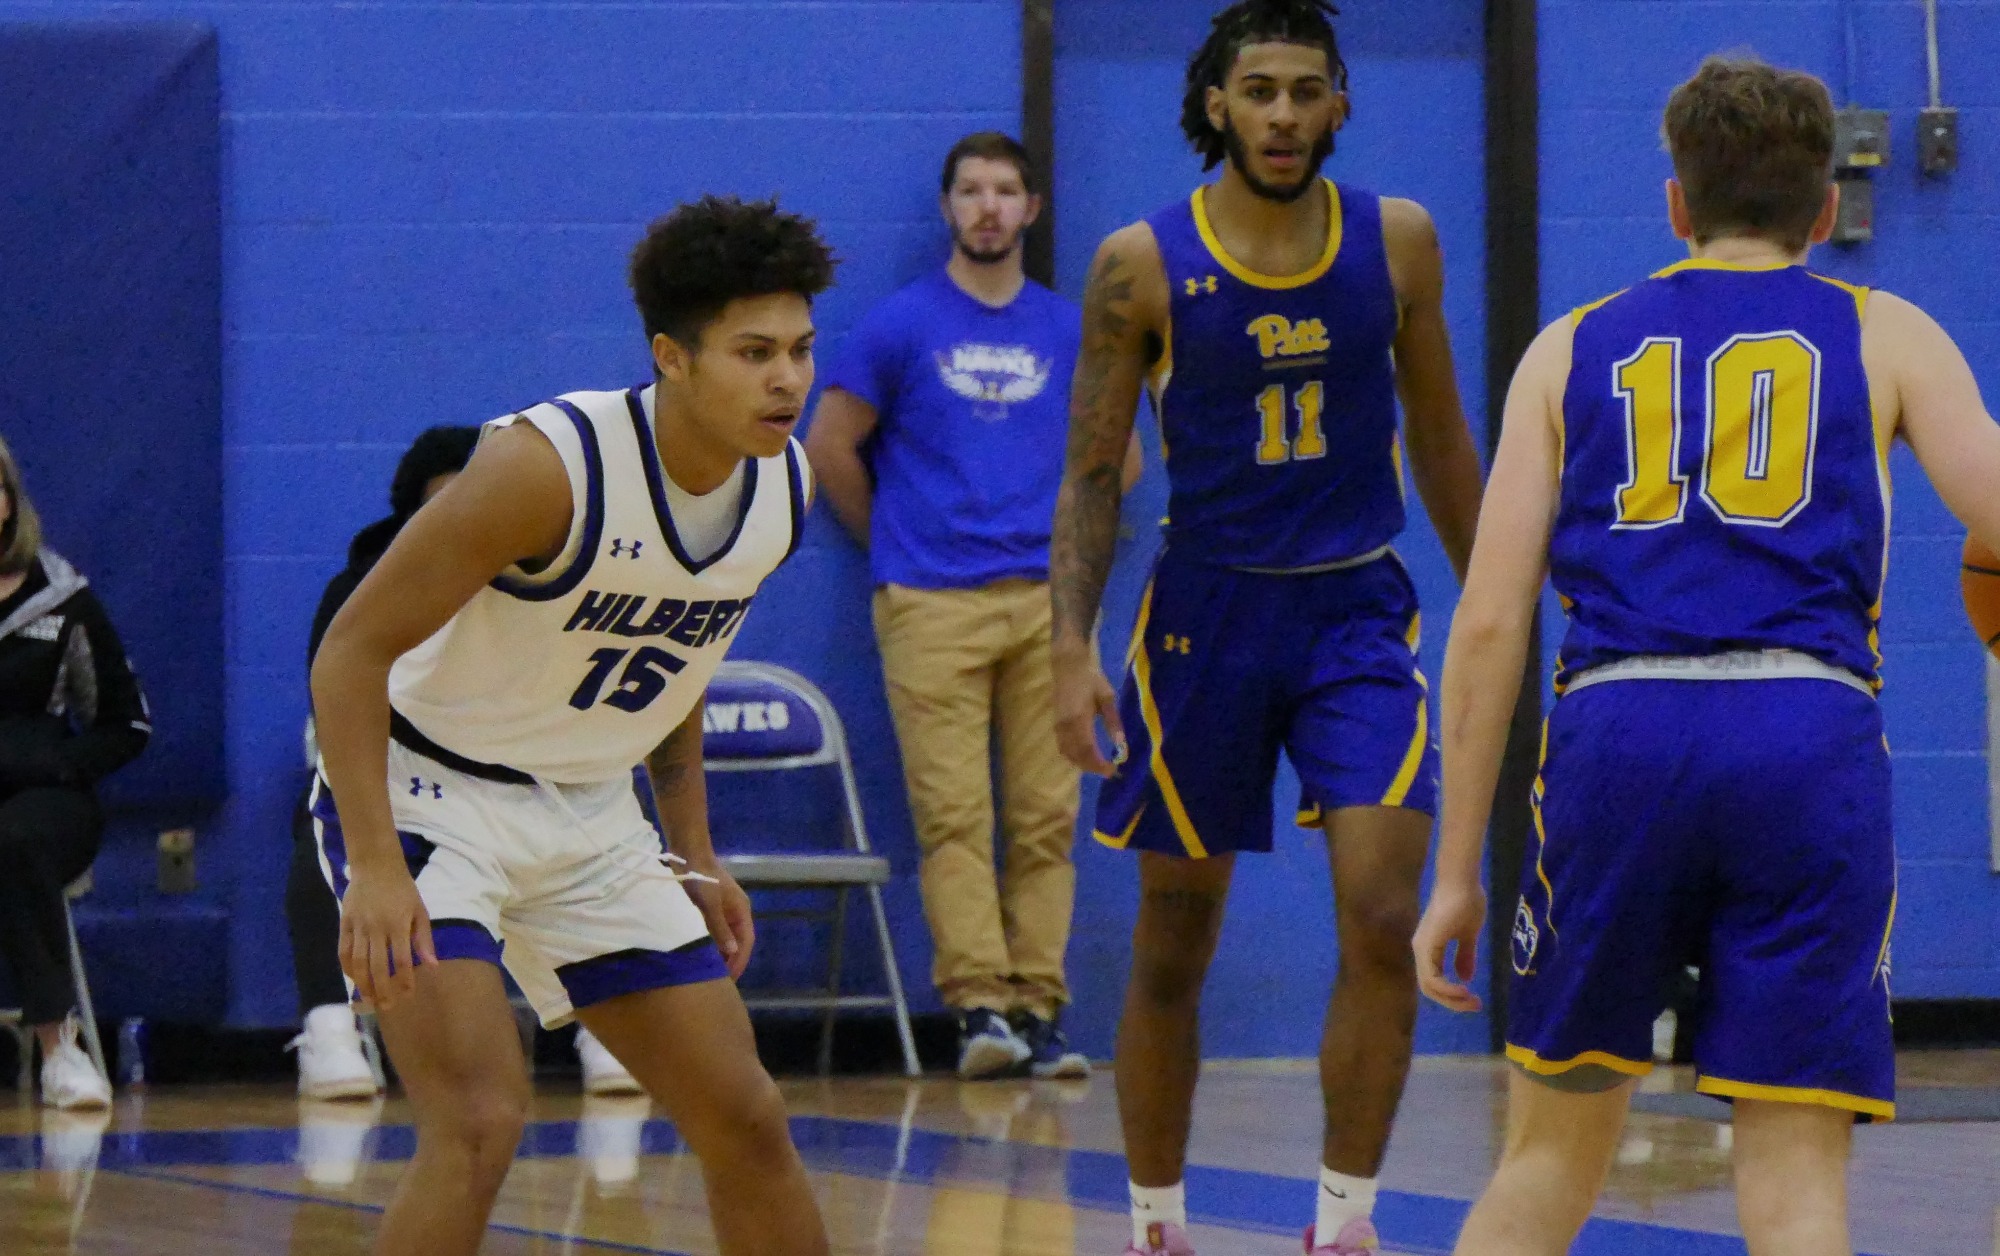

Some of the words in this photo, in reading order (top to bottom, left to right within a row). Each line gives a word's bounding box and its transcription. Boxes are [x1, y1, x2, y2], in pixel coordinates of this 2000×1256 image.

[1246, 314, 1331, 357] Pitt
[1255, 380, 1327, 465] 11
[1610, 330, 1822, 530] 10
[568, 646, 688, 713] 15
